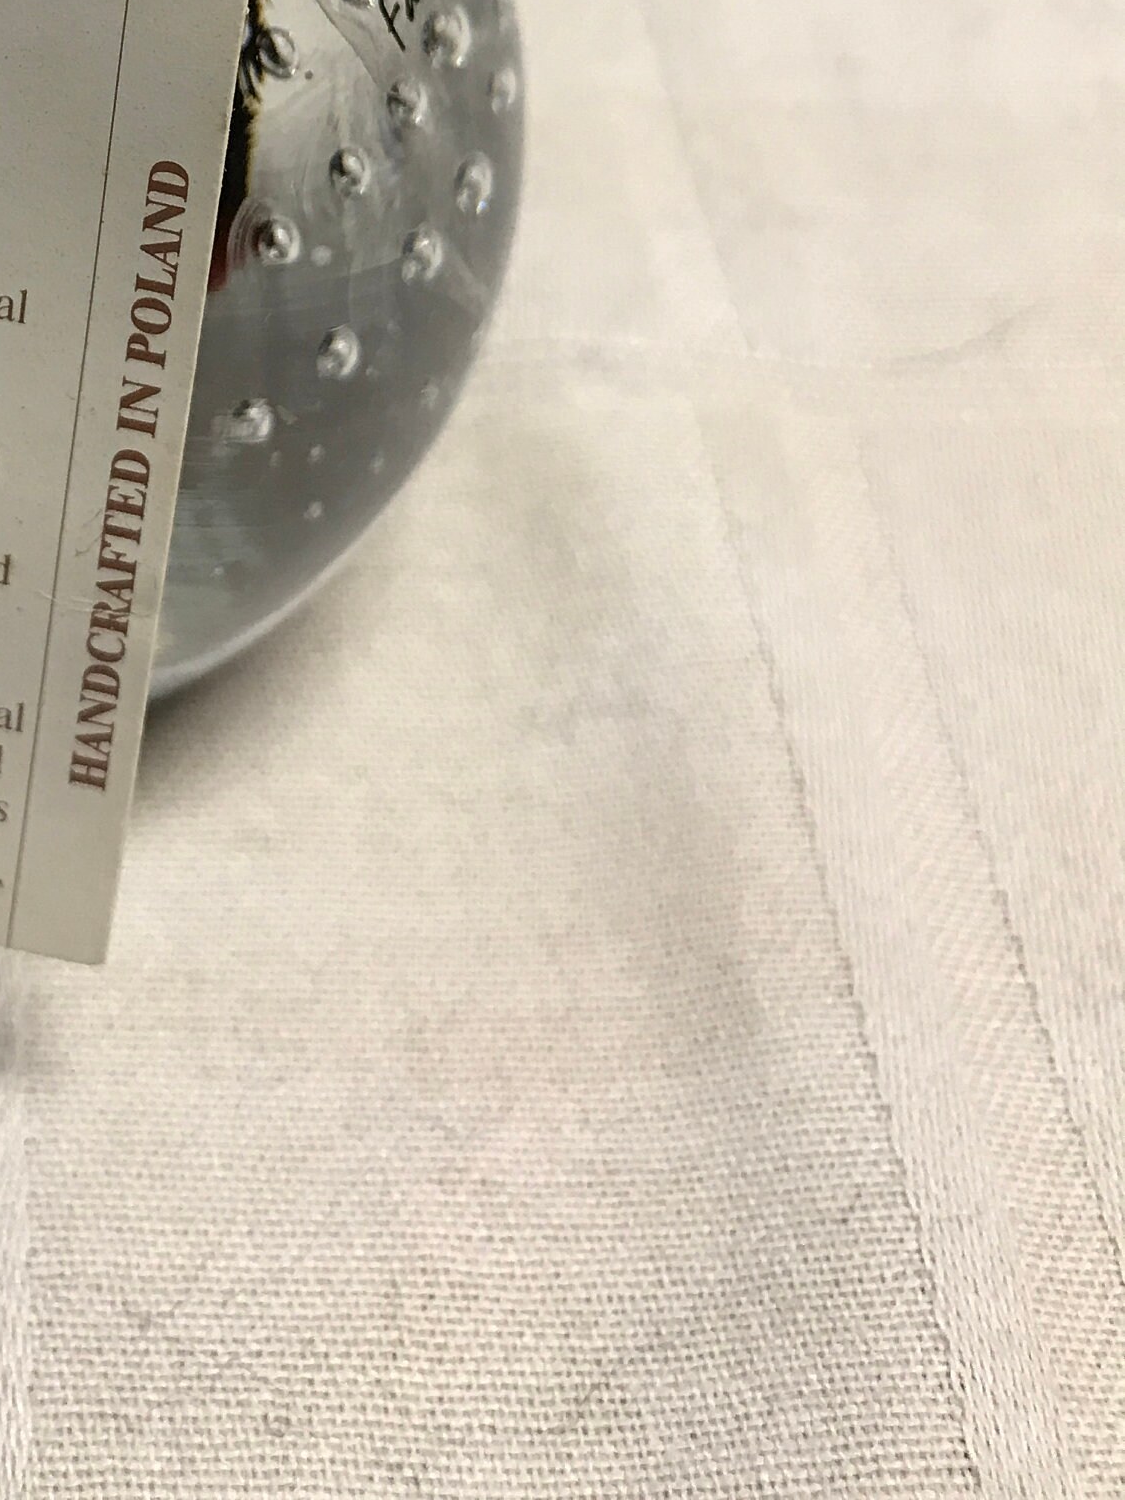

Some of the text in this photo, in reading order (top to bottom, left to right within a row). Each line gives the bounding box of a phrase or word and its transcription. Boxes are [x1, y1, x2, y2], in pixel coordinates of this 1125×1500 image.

[69, 160, 191, 792] HANDCRAFTED IN POLAND
